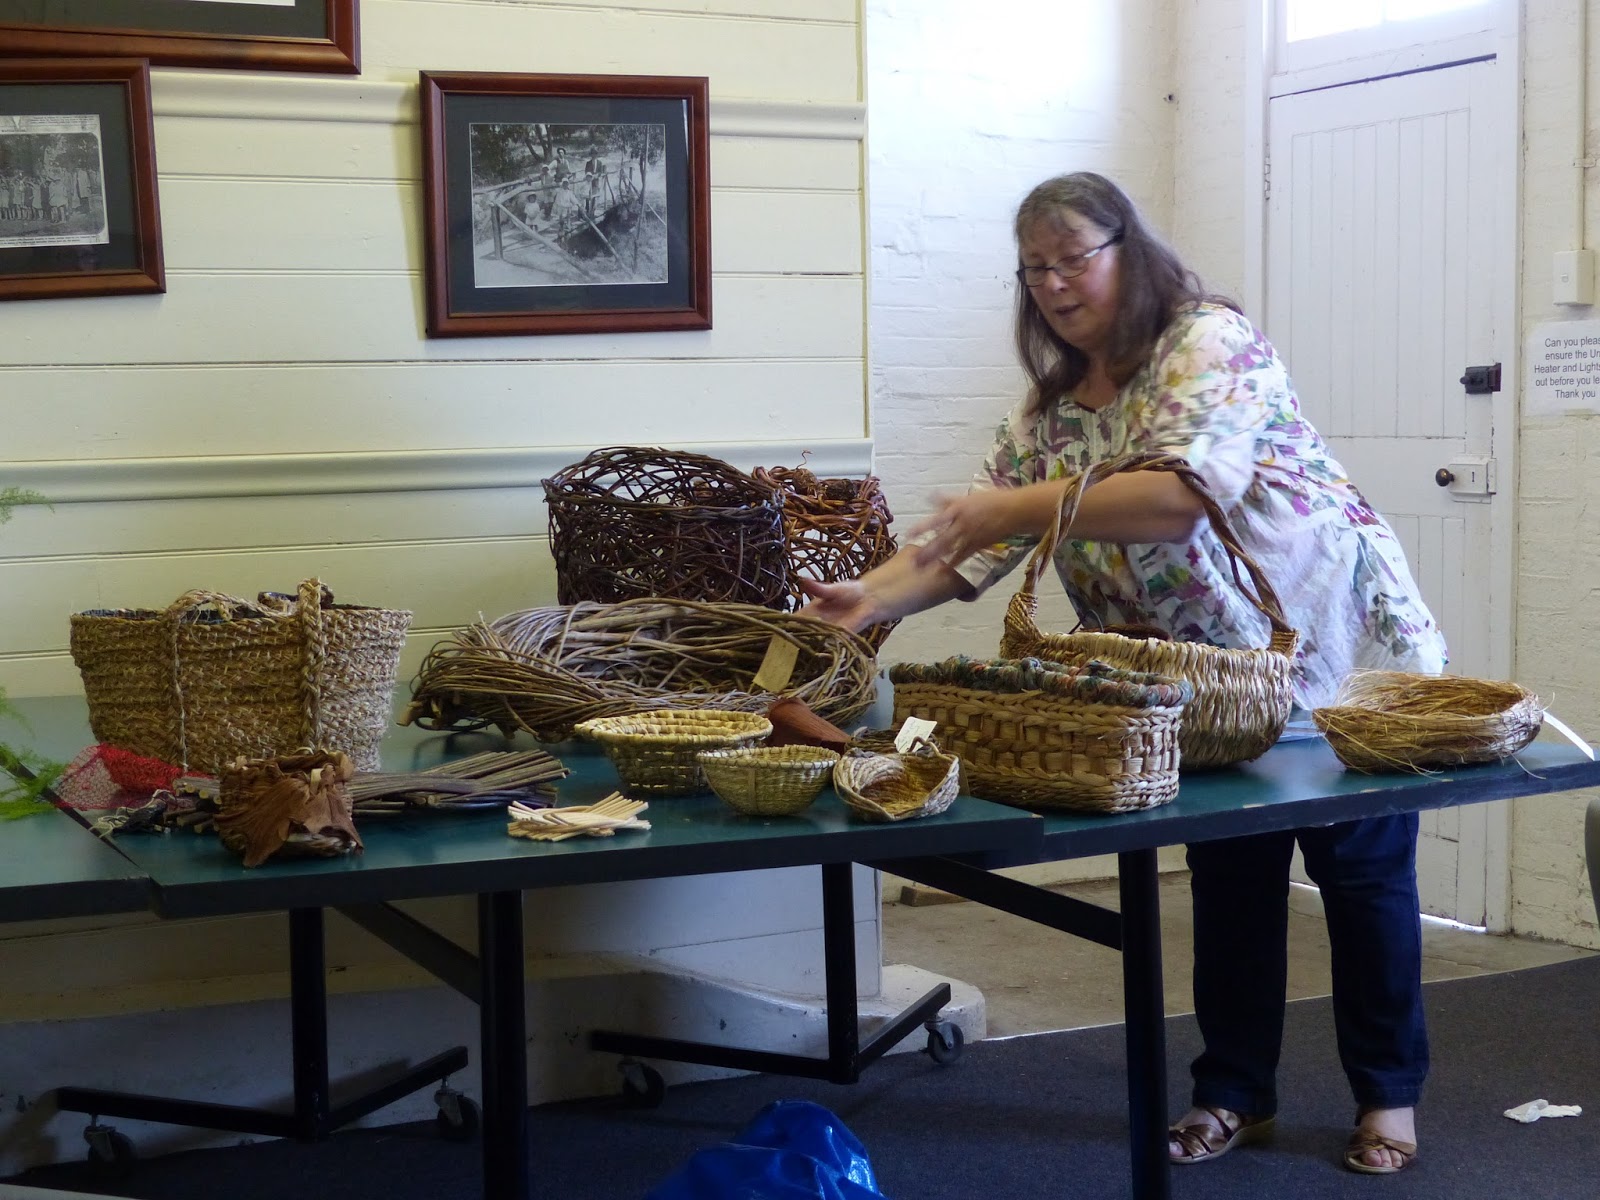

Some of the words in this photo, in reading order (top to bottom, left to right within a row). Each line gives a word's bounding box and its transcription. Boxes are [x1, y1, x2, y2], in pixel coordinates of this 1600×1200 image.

[1544, 338, 1561, 347] Can
[1563, 338, 1578, 348] you
[1545, 351, 1573, 360] ensure
[1575, 349, 1588, 359] the
[1534, 364, 1561, 374] Heater
[1562, 363, 1578, 373] and
[1535, 378, 1548, 387] out
[1549, 376, 1575, 386] before
[1576, 377, 1591, 387] you
[1555, 389, 1580, 399] Thank
[1581, 390, 1596, 400] you
